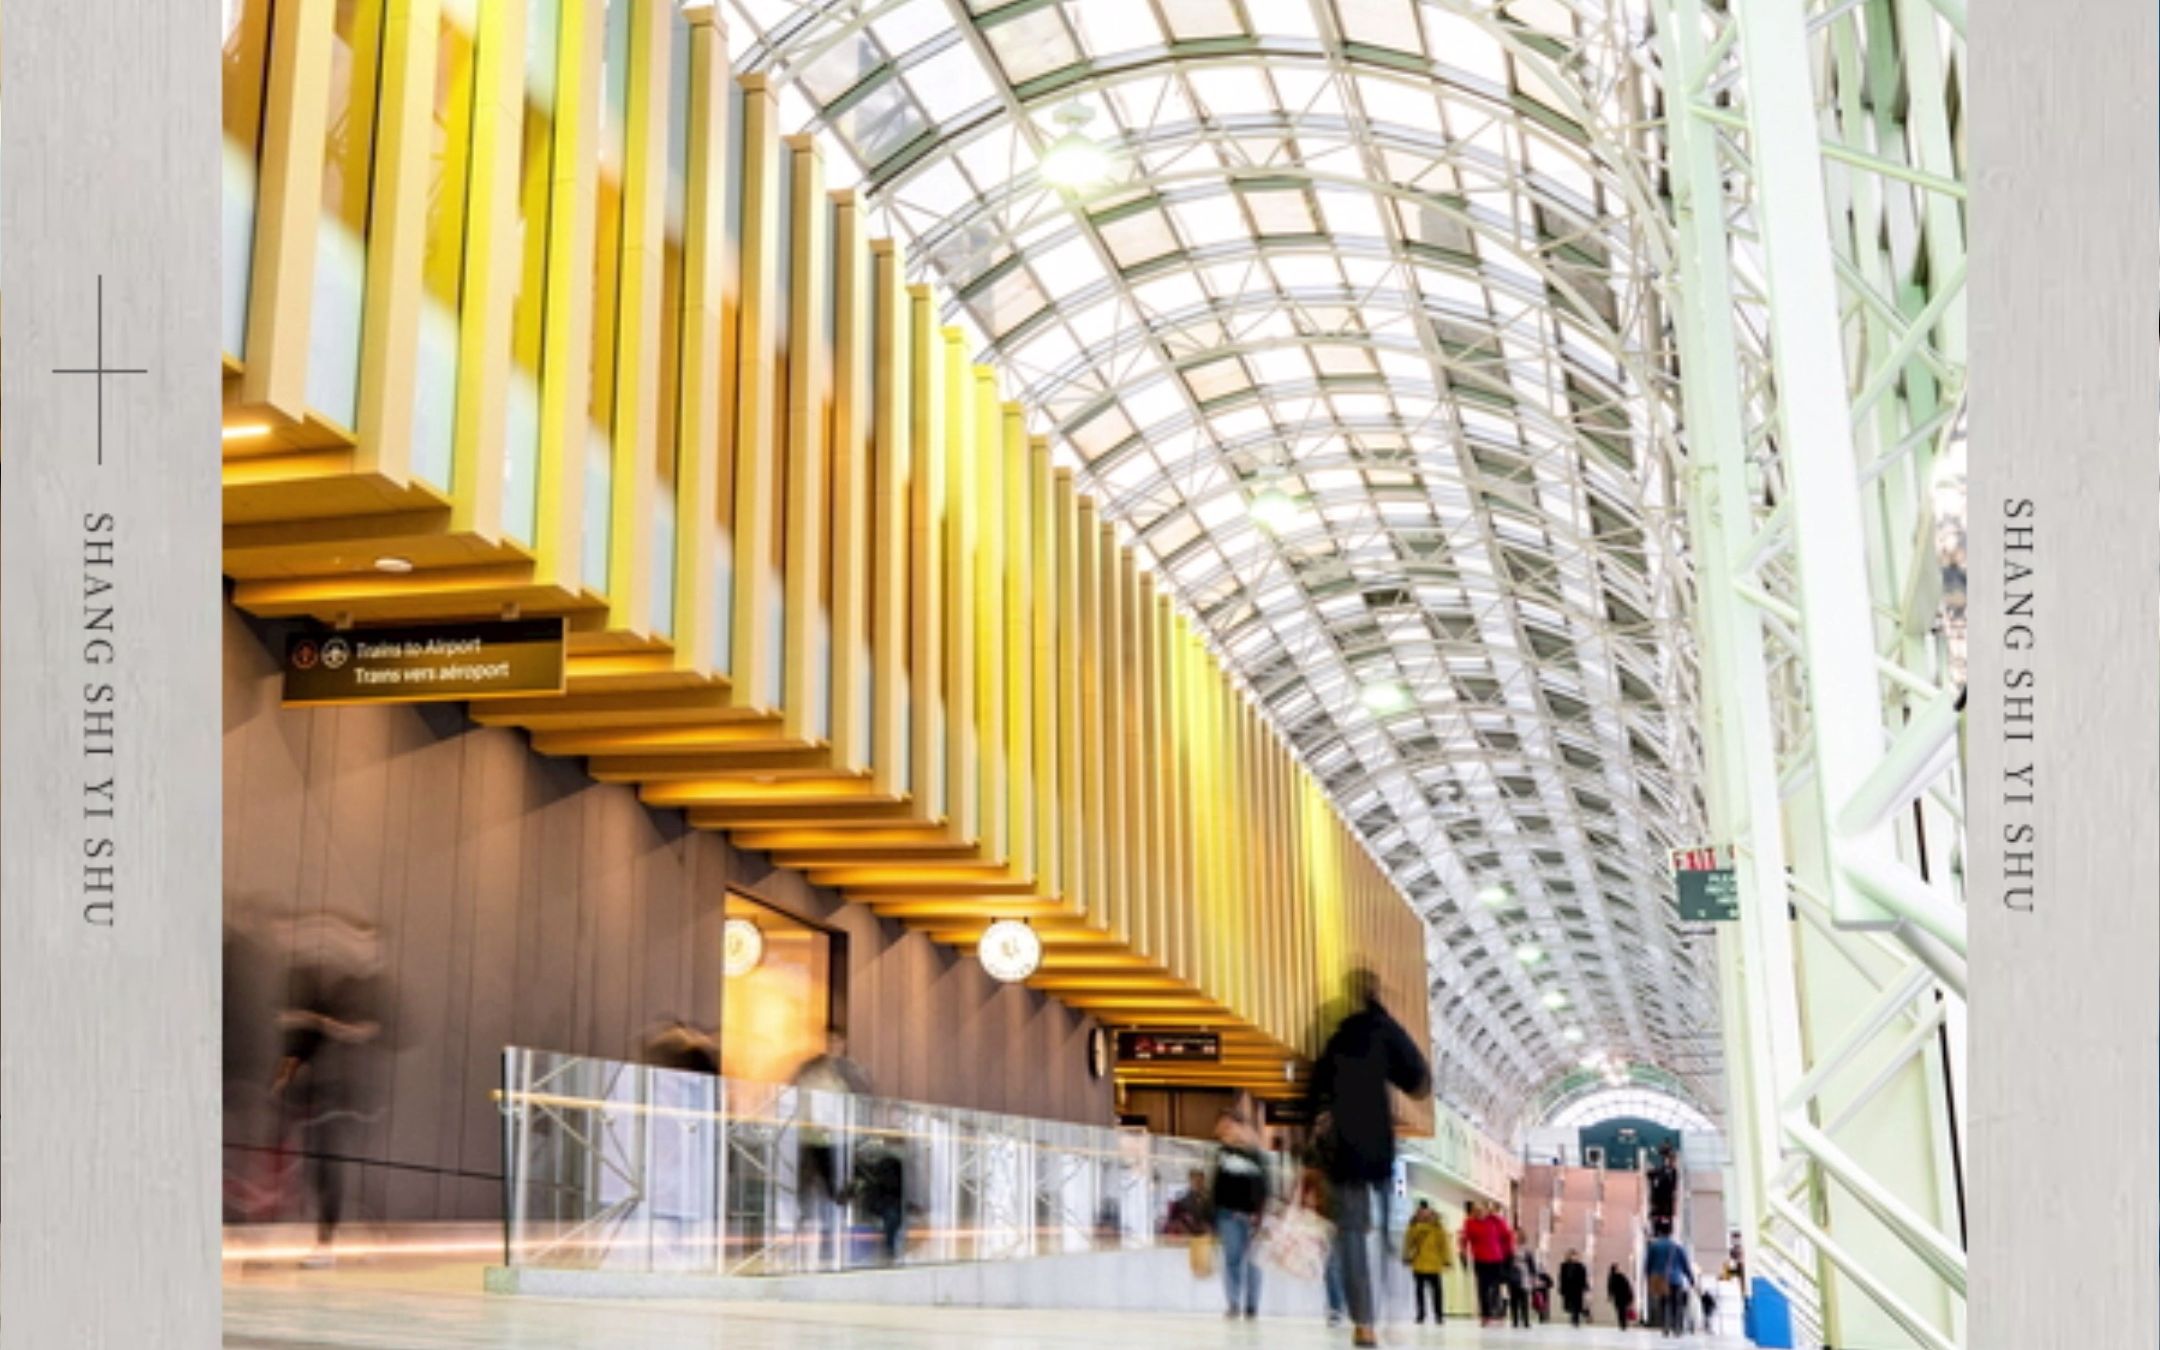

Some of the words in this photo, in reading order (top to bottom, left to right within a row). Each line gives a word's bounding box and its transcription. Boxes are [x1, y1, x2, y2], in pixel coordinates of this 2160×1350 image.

[356, 642, 401, 659] Trains
[403, 640, 423, 657] to
[425, 635, 481, 657] Airport
[403, 666, 435, 683] vers
